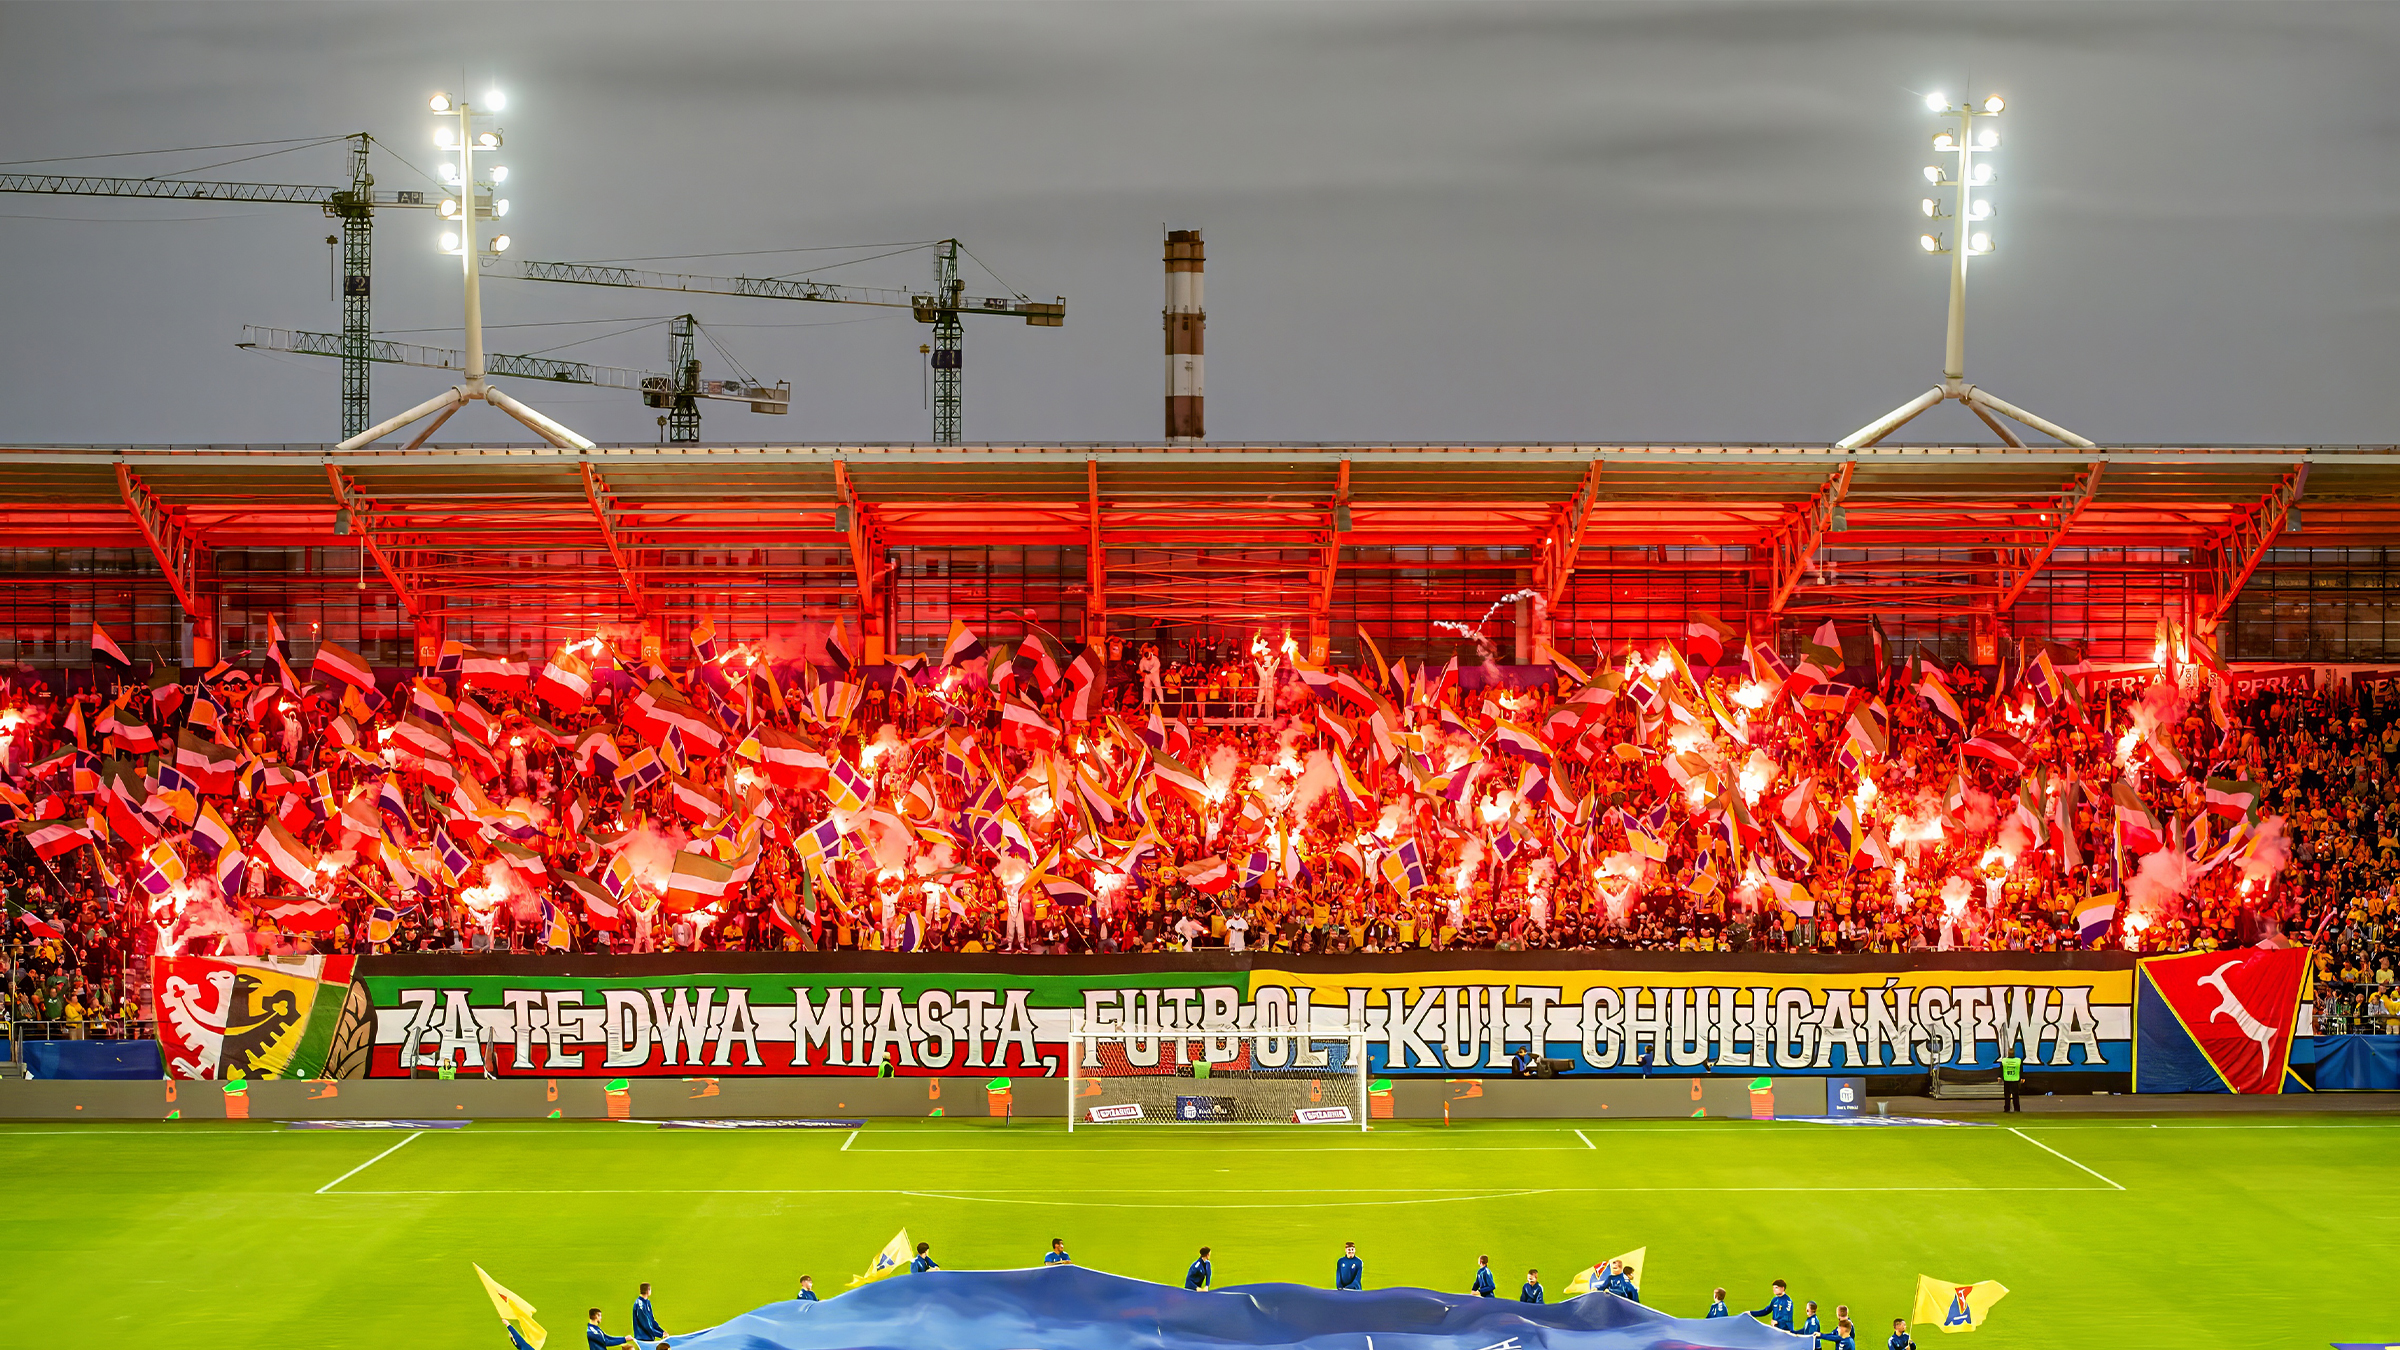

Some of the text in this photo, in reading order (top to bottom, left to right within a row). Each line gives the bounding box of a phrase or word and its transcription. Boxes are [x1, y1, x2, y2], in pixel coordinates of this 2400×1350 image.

[1978, 645, 1994, 657] H2
[399, 976, 2108, 1077] ZA TE DWA MIASTA, FUTBOL I KULT CHULIGAŃSTWA
